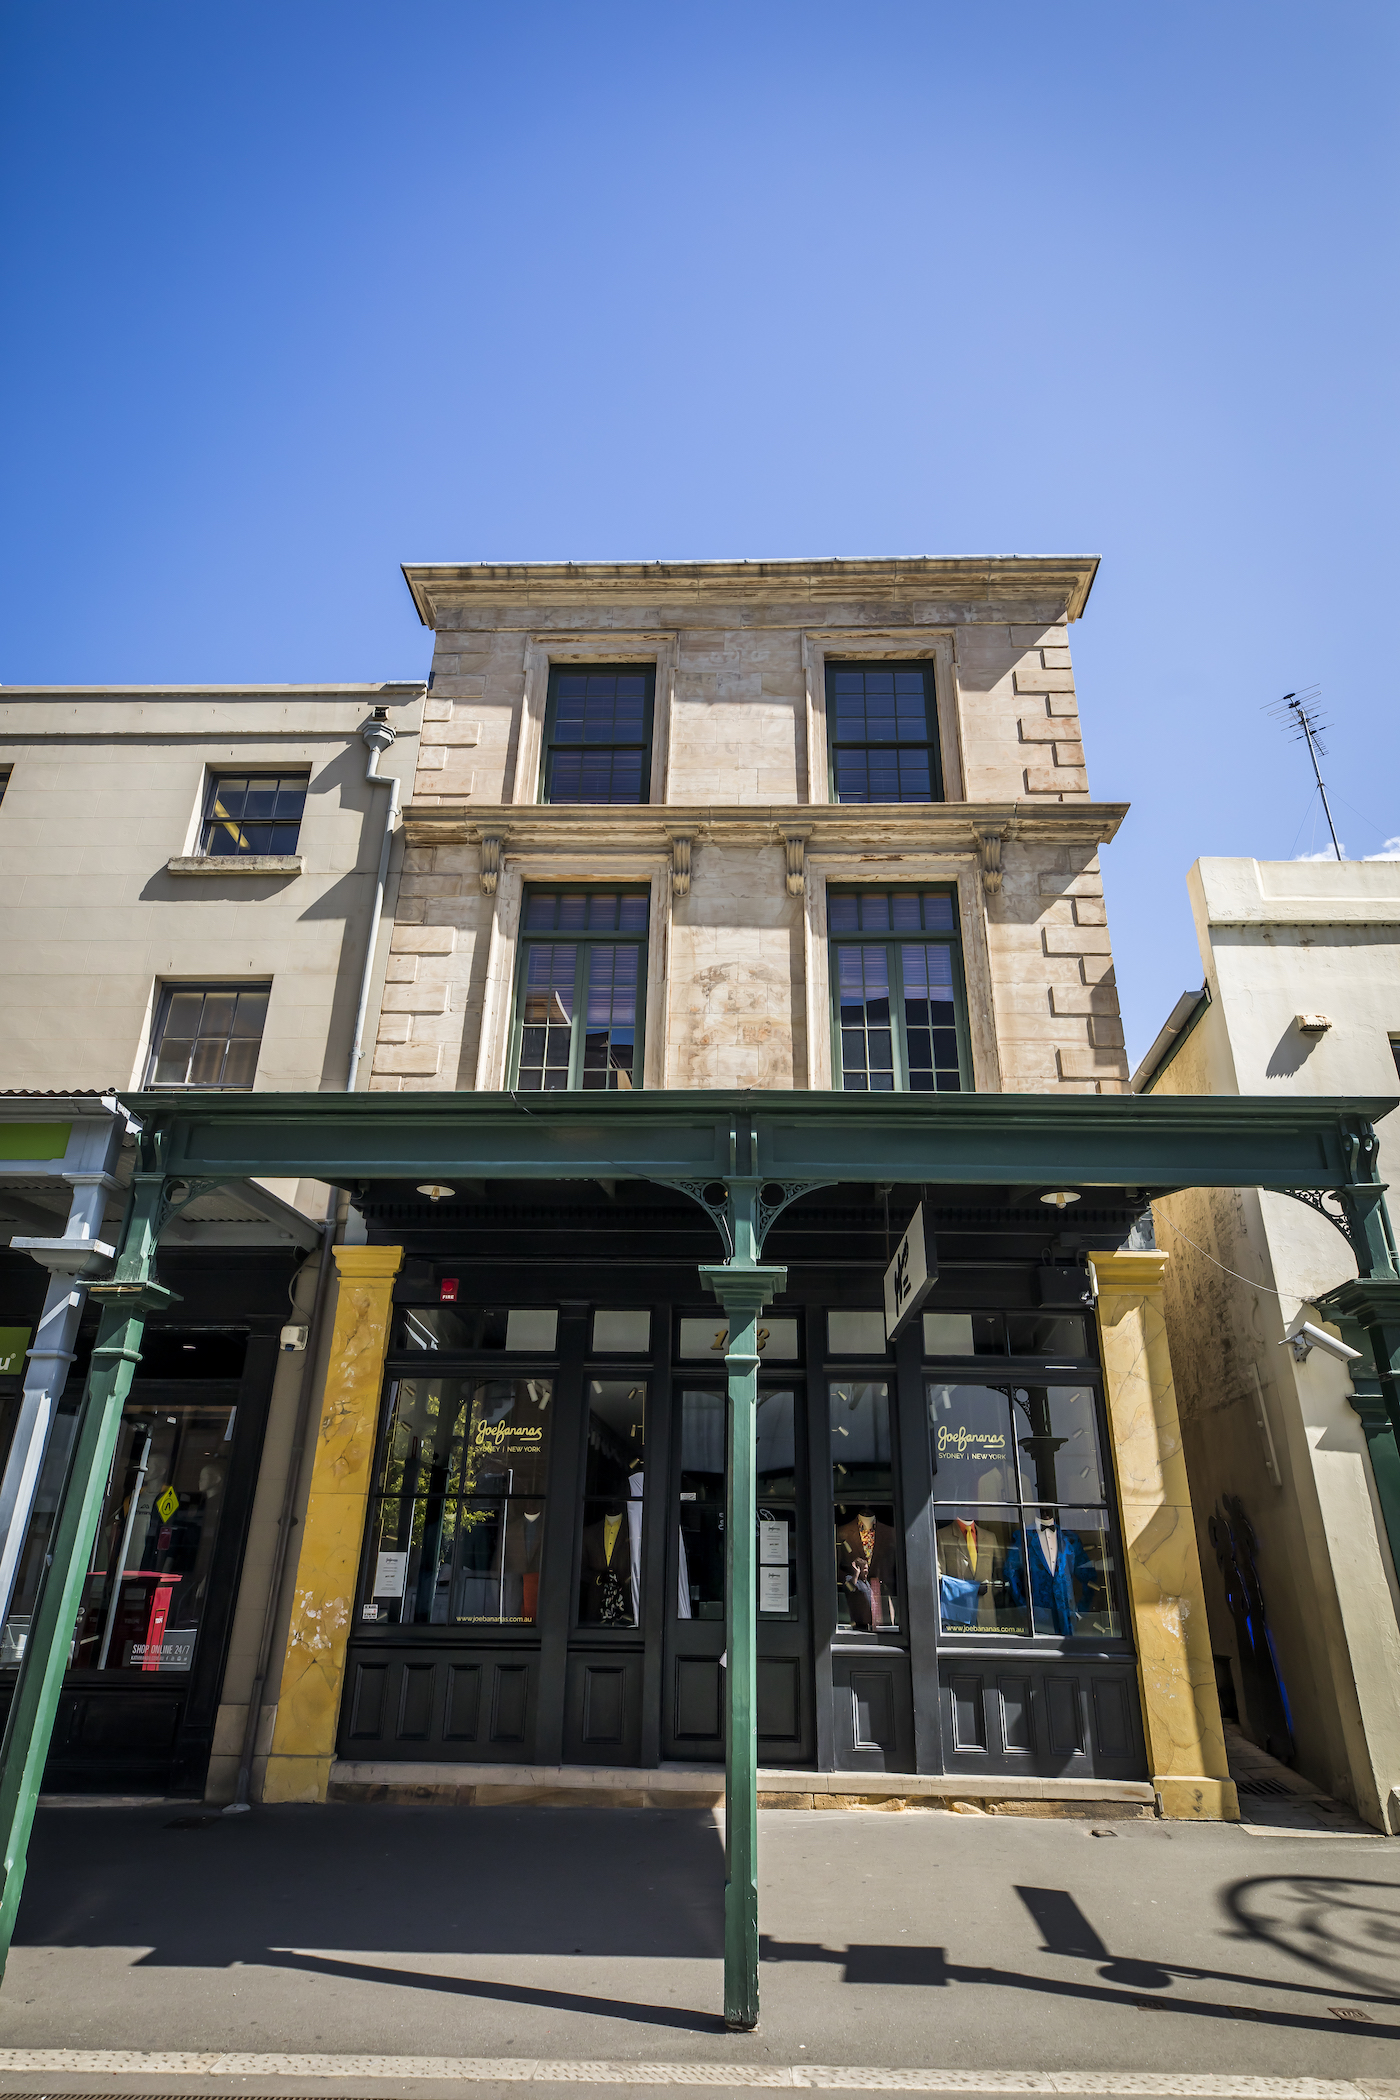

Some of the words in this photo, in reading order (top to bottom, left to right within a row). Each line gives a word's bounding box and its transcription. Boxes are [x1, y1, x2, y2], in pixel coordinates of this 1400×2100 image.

[710, 1328, 770, 1351] 13
[938, 1452, 965, 1460] SYDNEY
[945, 1625, 1025, 1634] www.joebananas.com.au
[132, 1644, 150, 1654] SHOP
[150, 1644, 173, 1655] ONLINE
[174, 1645, 191, 1655] 24/7
